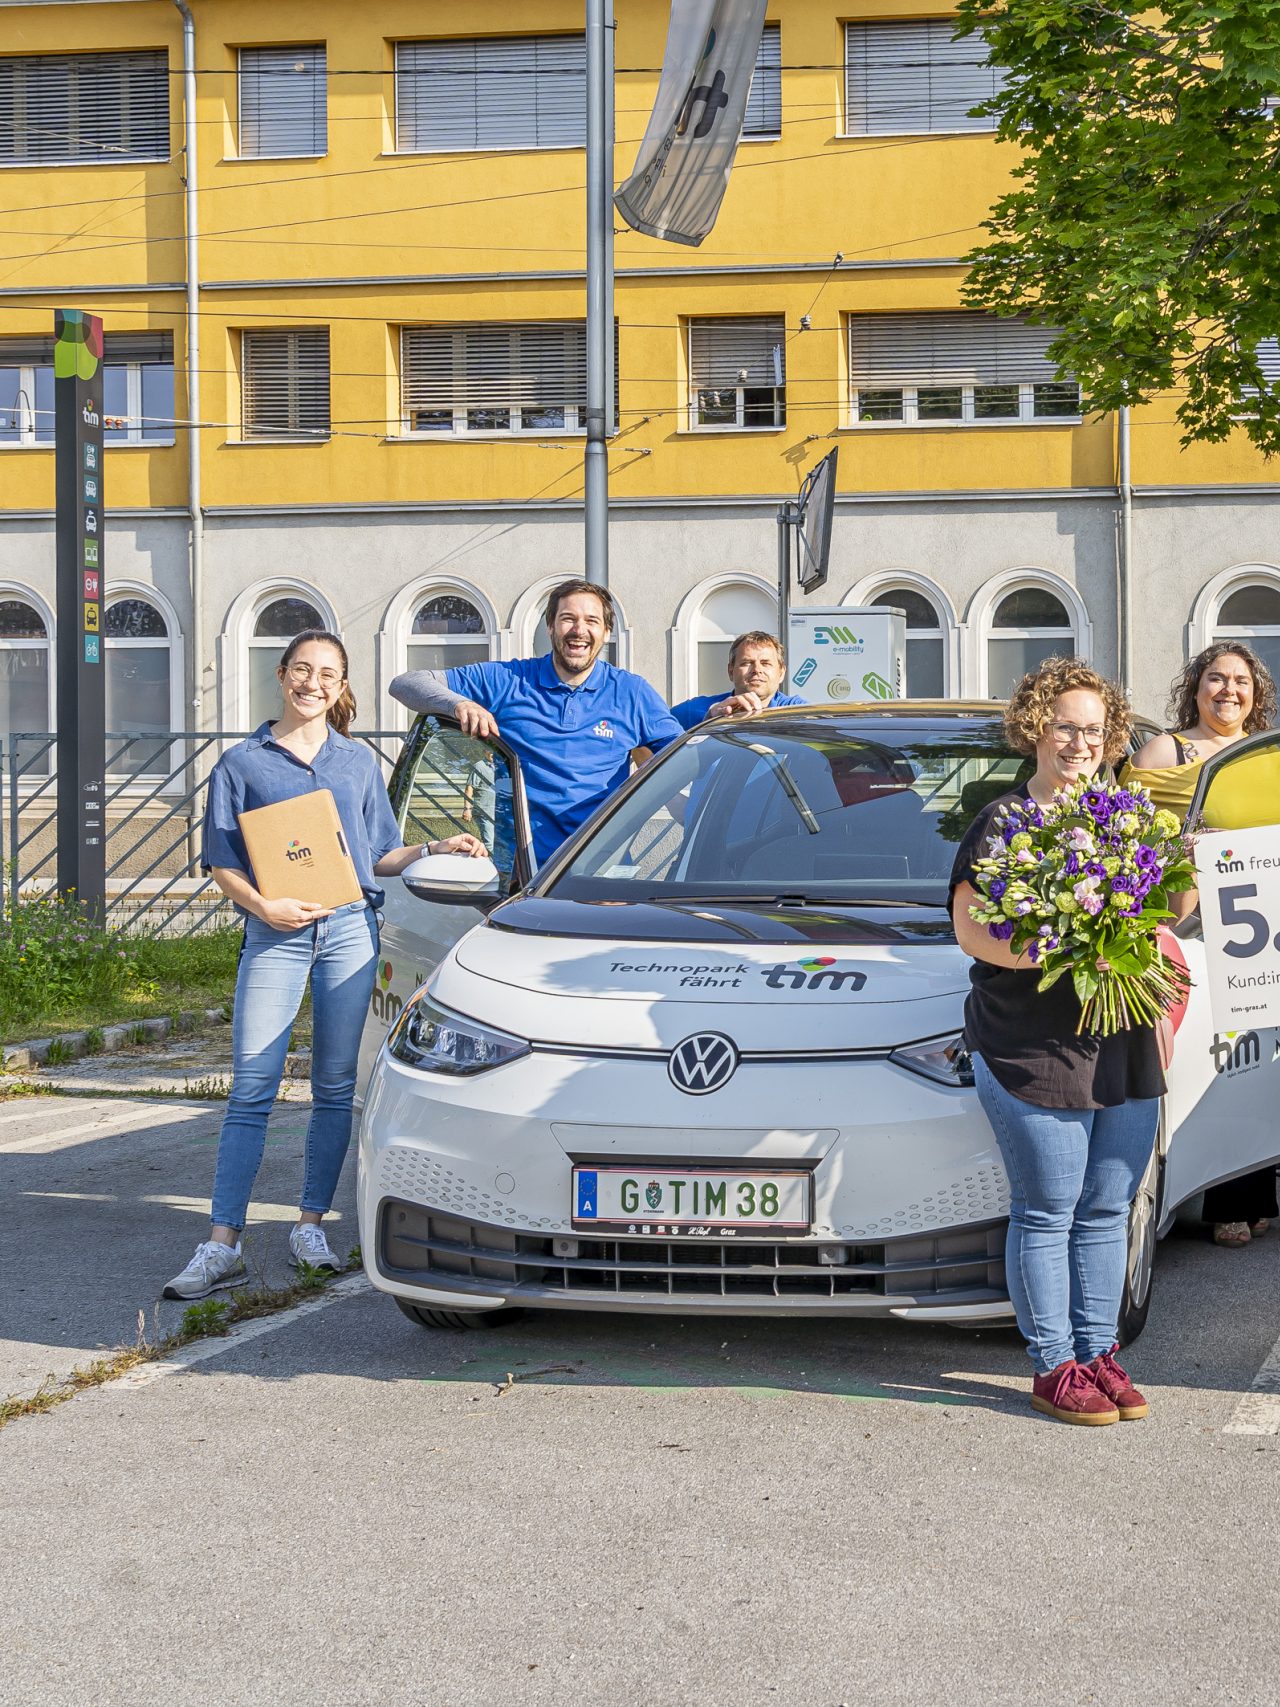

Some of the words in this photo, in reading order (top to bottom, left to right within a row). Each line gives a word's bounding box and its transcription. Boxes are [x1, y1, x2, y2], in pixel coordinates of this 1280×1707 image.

[83, 400, 99, 427] tim
[832, 645, 864, 653] e-mobility
[593, 721, 613, 739] tim
[286, 843, 312, 861] tim
[1215, 853, 1244, 874] tim
[610, 962, 752, 977] Technopark
[760, 958, 868, 992] tim
[678, 976, 742, 988] fährt
[1230, 1003, 1268, 1014] tim-graz.at
[1209, 1031, 1260, 1073] tim
[620, 1179, 639, 1214] G
[583, 1201, 592, 1212] A
[720, 1228, 737, 1236] Graz
